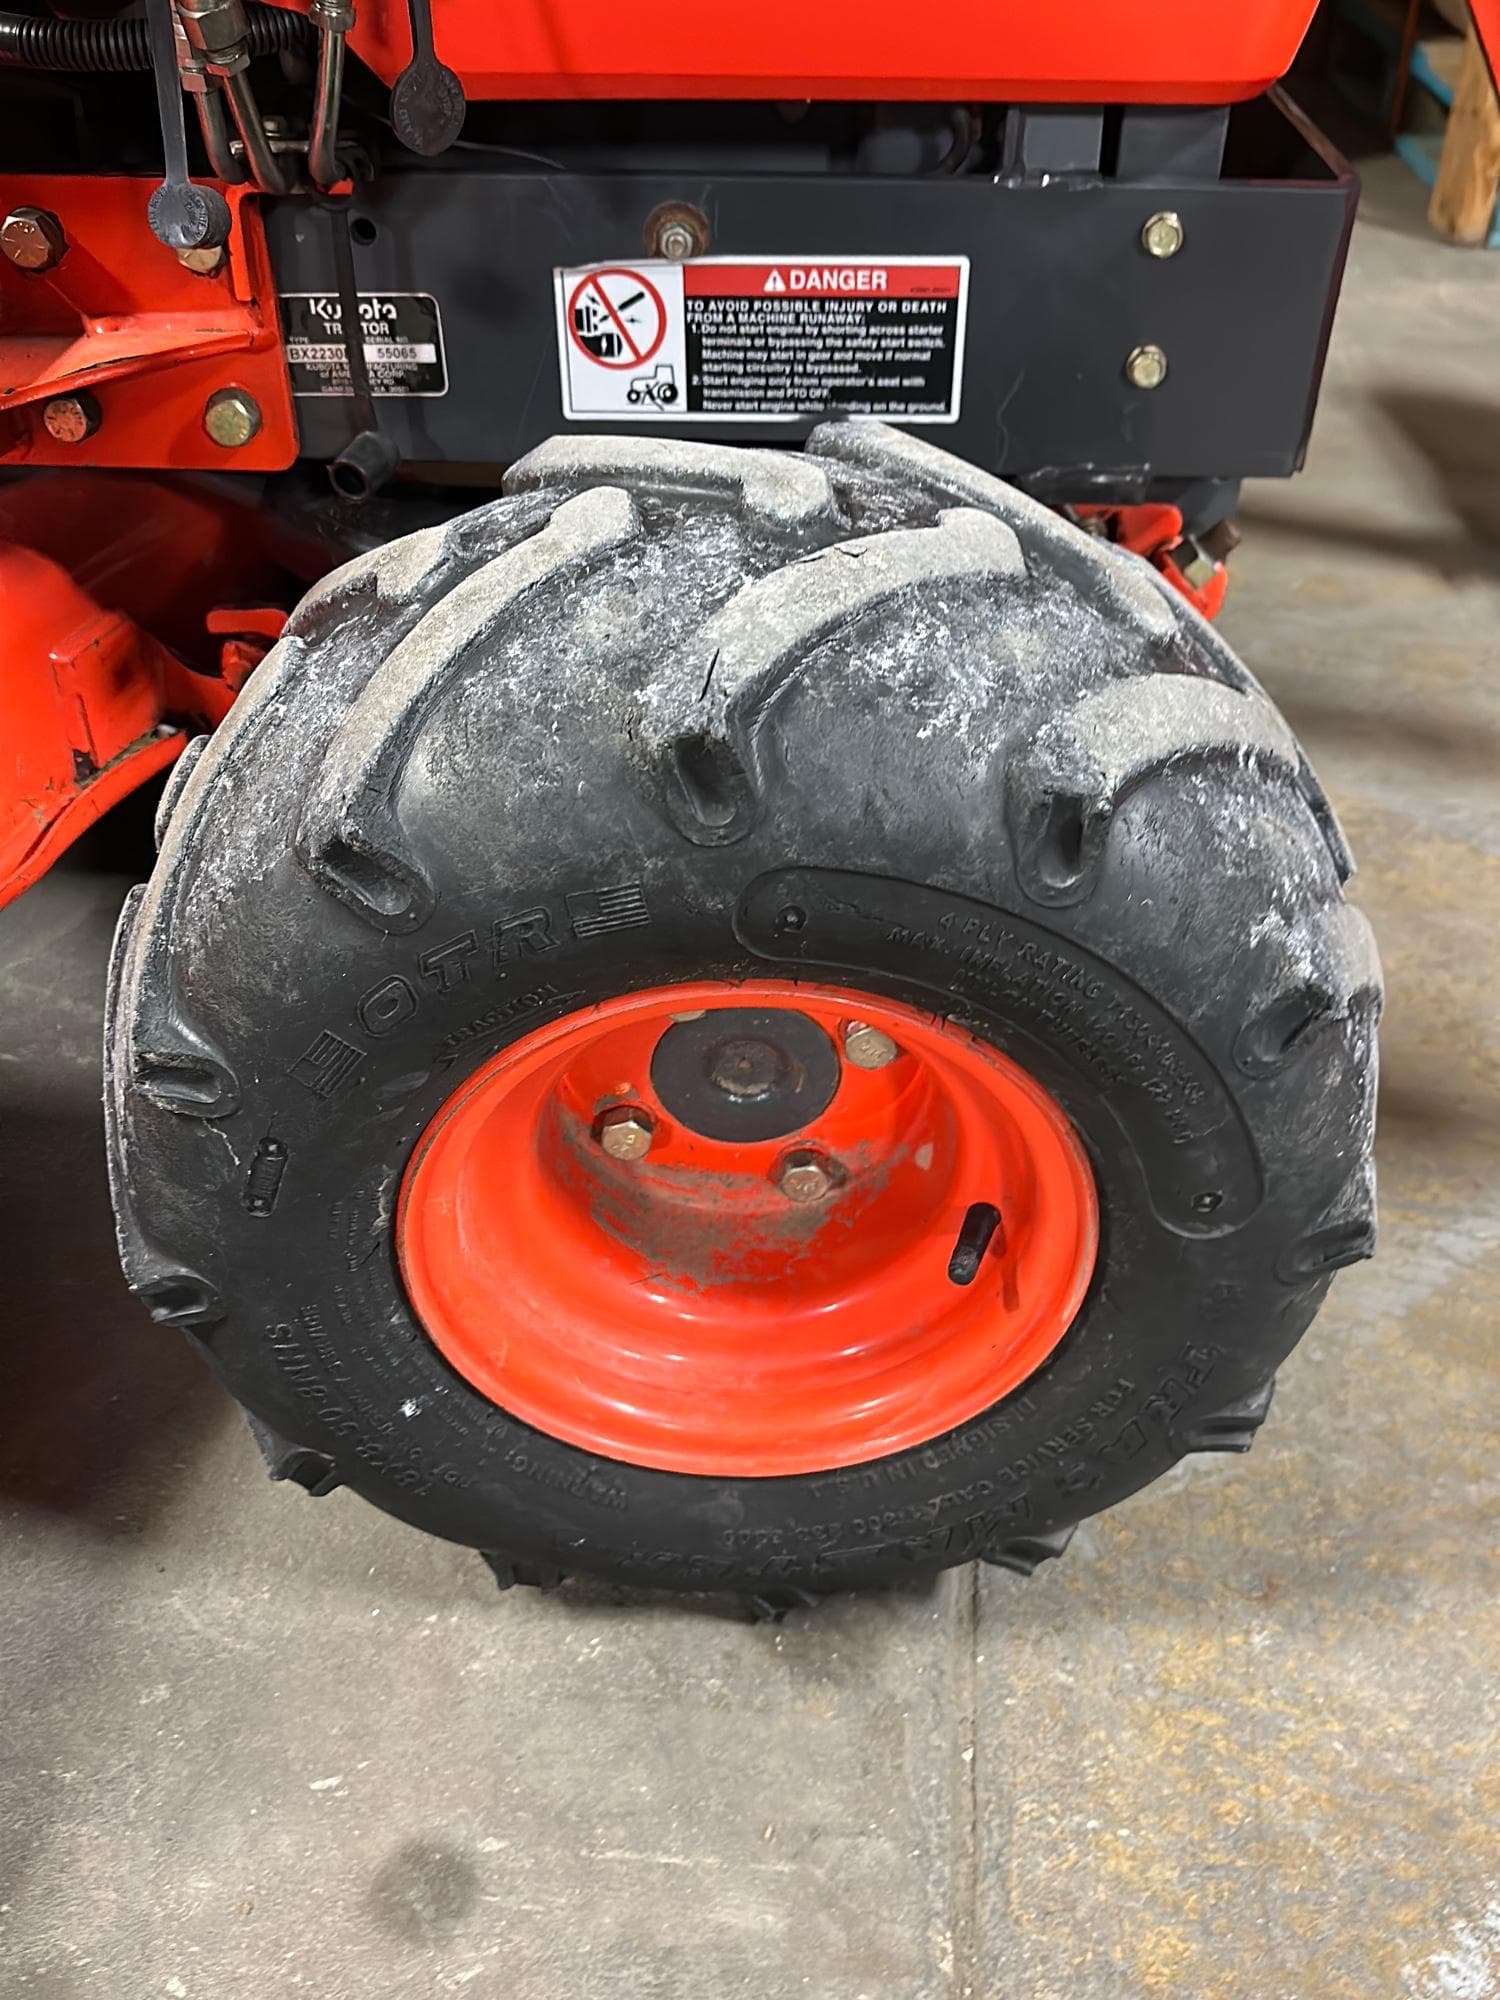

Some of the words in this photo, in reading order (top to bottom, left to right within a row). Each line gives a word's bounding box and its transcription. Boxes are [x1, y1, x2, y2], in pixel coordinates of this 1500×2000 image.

[789, 269, 888, 291] DANGER
[308, 297, 398, 320] Kuota
[686, 300, 705, 313] TO
[708, 300, 750, 313] AVOID
[753, 301, 821, 313] POSSIBLE
[824, 301, 874, 313] INJURY
[877, 301, 898, 313] OR
[901, 301, 947, 314] DEATH
[686, 312, 723, 323] FROM
[726, 312, 736, 323] A
[738, 312, 797, 324] MACHINE
[322, 321, 390, 335] TRTOR
[701, 324, 718, 334] Do
[719, 324, 737, 334] not
[739, 324, 765, 335] start
[766, 326, 804, 338] engine
[805, 325, 820, 337] by
[377, 347, 418, 359] 55065
[355, 905, 562, 1039] OTR
[1016, 940, 1106, 999] RATING
